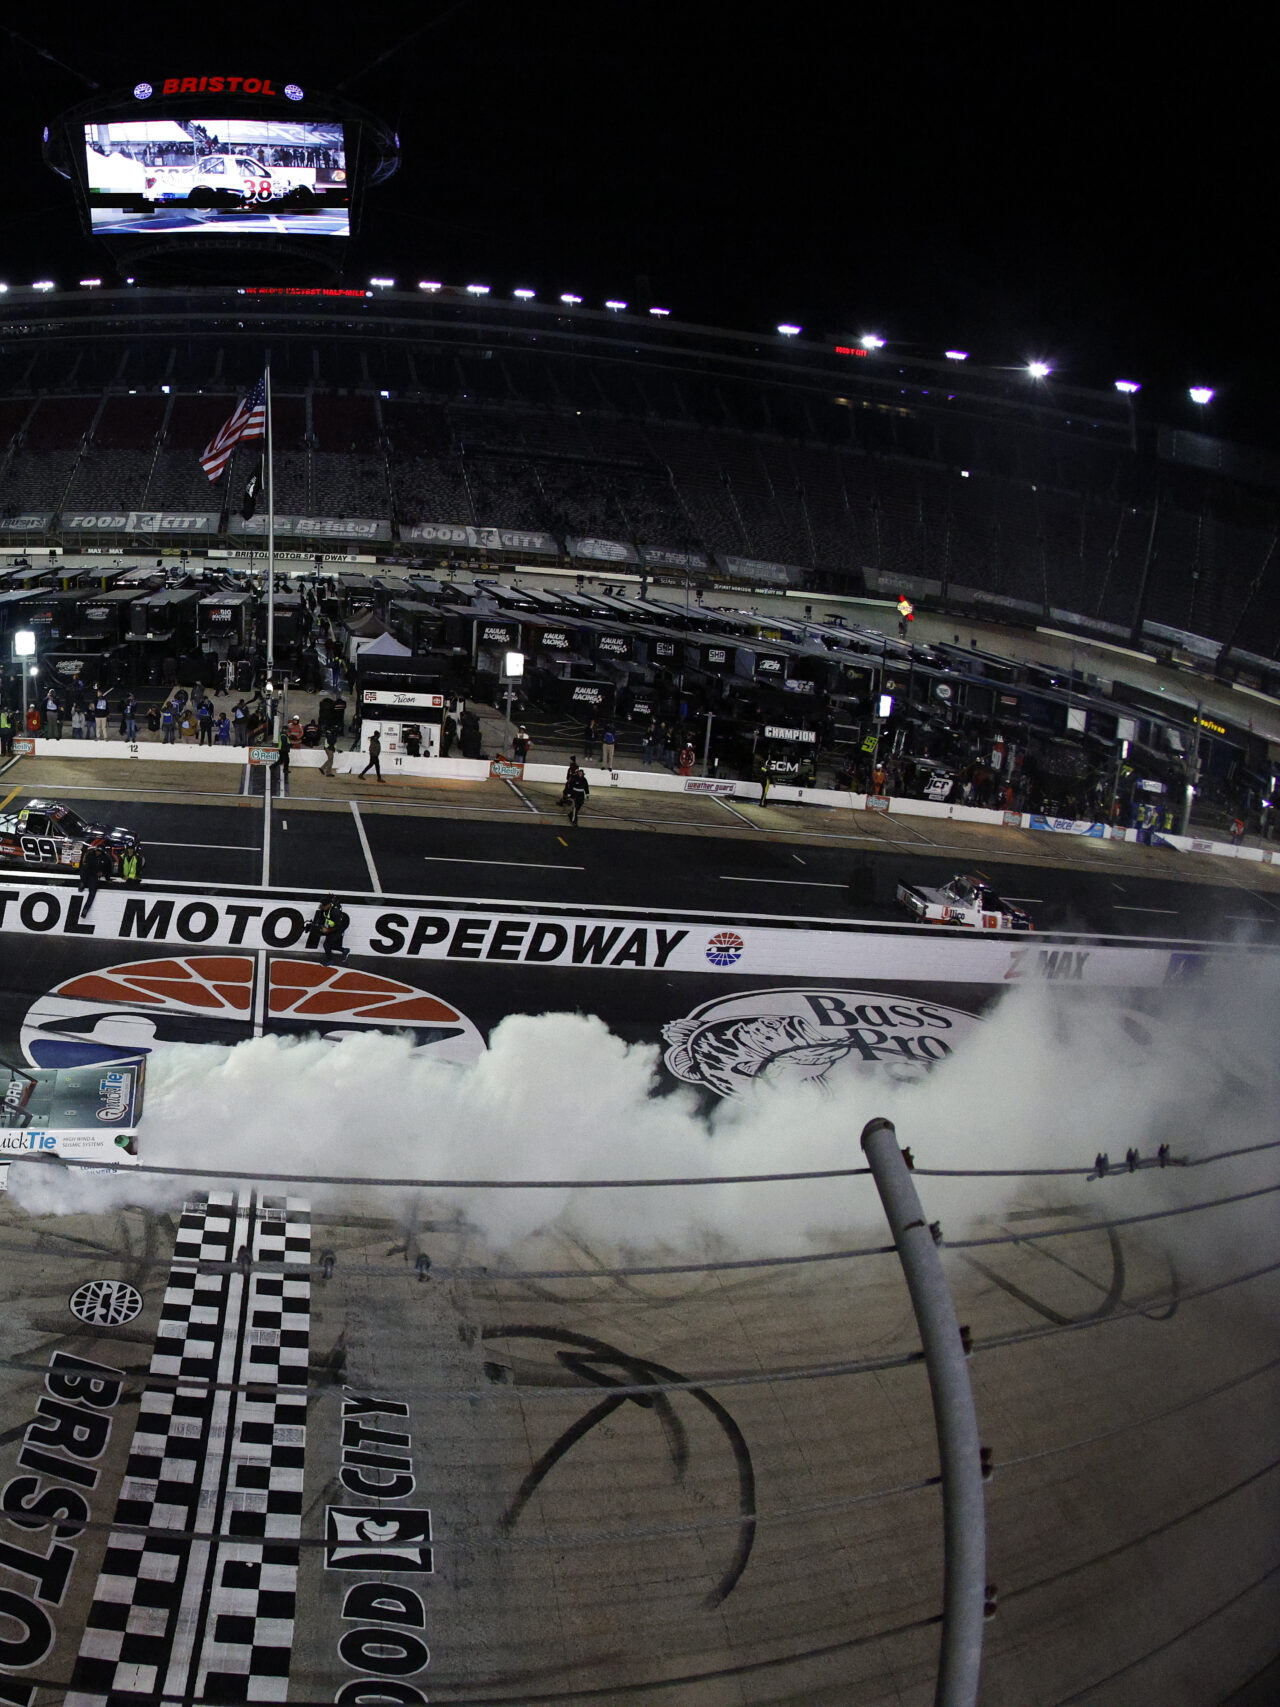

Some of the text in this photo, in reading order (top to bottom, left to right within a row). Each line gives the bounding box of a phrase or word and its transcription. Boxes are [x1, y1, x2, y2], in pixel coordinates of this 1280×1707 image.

[163, 77, 276, 96] BRISTOL
[242, 179, 272, 202] 38
[69, 515, 208, 528] FOOD CITY
[235, 551, 269, 559] BRISTOL
[273, 552, 301, 560] MOTOR
[542, 638, 563, 646] RACING
[544, 633, 565, 641] KAULIG
[602, 637, 624, 645] KAULIG
[600, 643, 622, 651] RACING
[576, 687, 599, 695] KAULIG
[393, 693, 416, 704] Tricon
[573, 693, 597, 702] RACING
[764, 727, 816, 743] CHAMPION
[130, 745, 138, 753] 12
[493, 763, 521, 776] O'Reilly
[611, 772, 619, 781] 10
[687, 781, 734, 793] weather guard
[20, 835, 59, 865] 99
[369, 912, 690, 969] SPEEDWAY
[803, 994, 953, 1030] Bass
[843, 1026, 952, 1062] Pro
[338, 1384, 417, 1499] CITY
[333, 1580, 431, 1707] OOD
